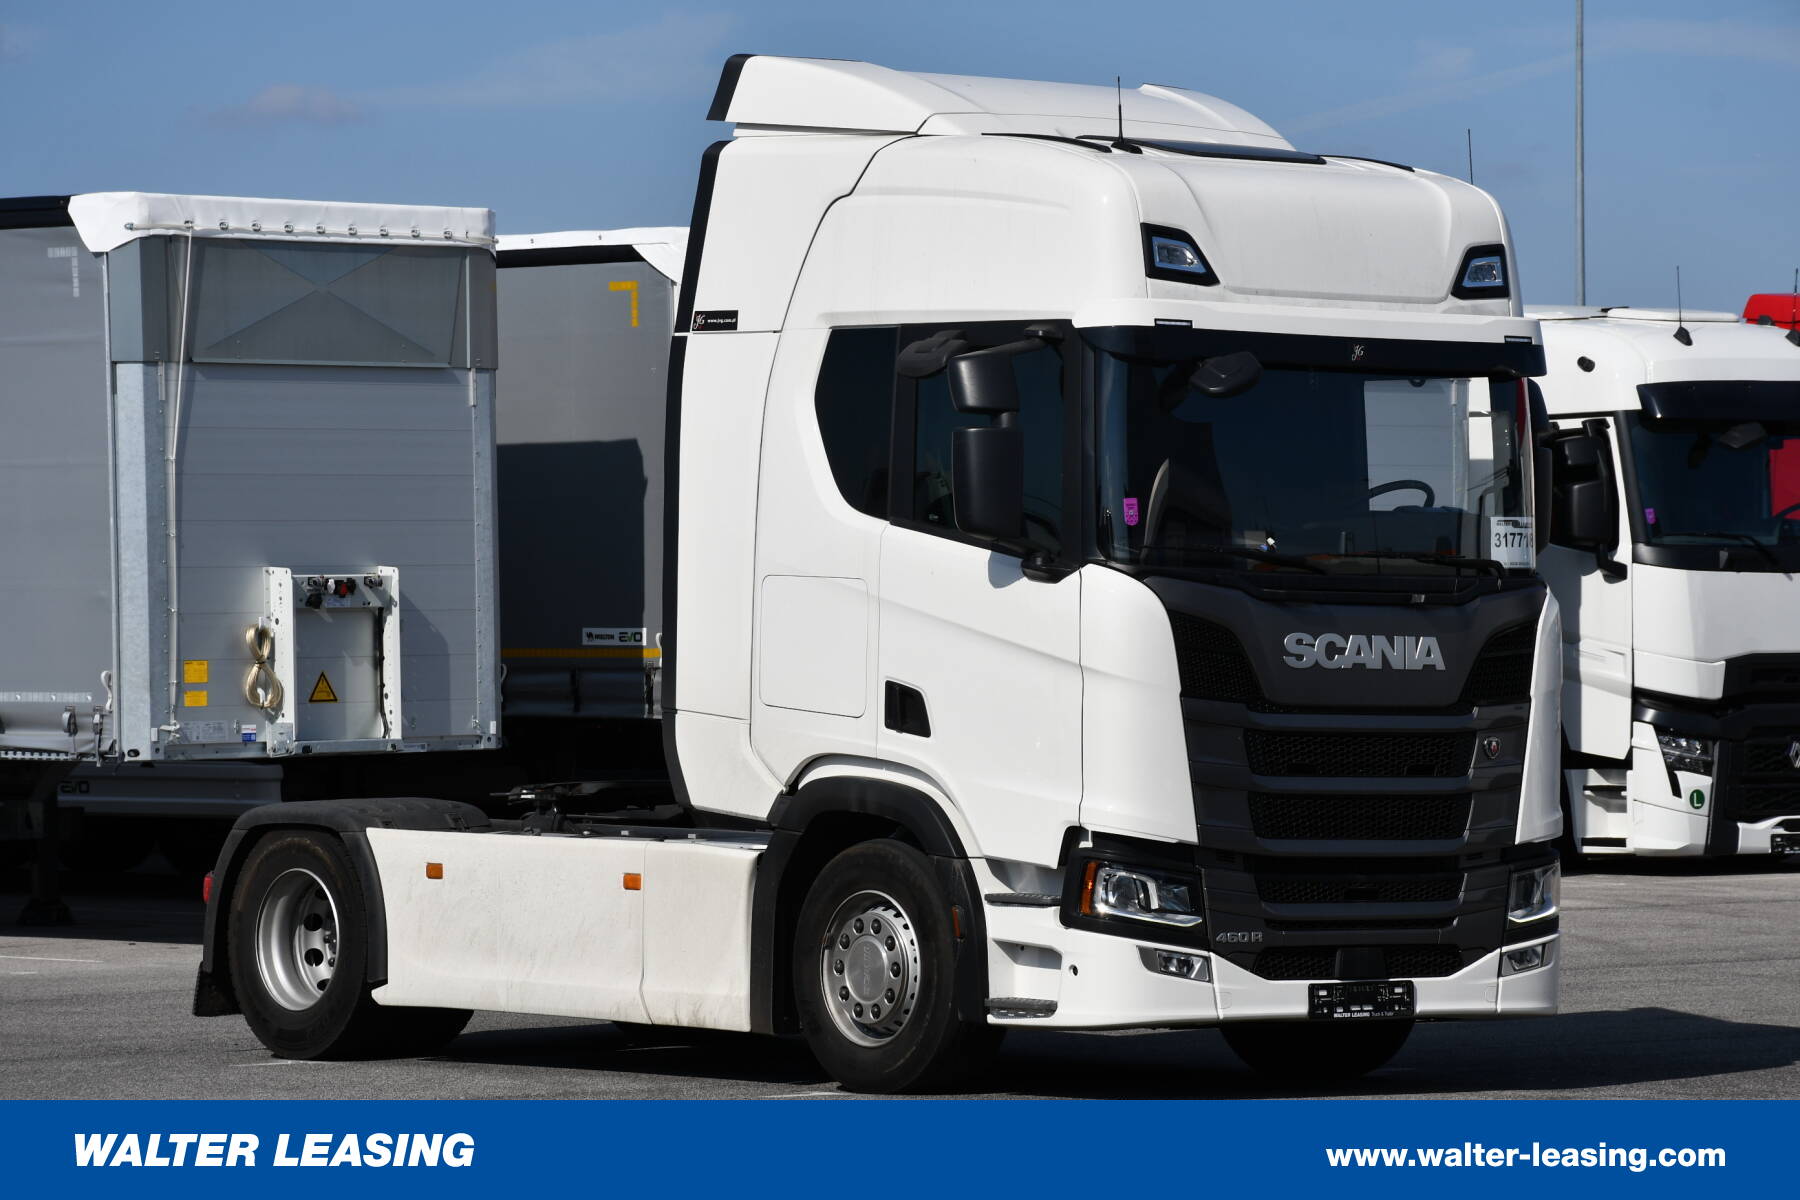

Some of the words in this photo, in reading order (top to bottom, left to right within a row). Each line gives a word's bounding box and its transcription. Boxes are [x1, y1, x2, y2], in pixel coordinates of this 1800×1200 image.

[618, 631, 643, 643] EVO
[1283, 632, 1446, 671] SCANIA
[1693, 792, 1702, 807] L
